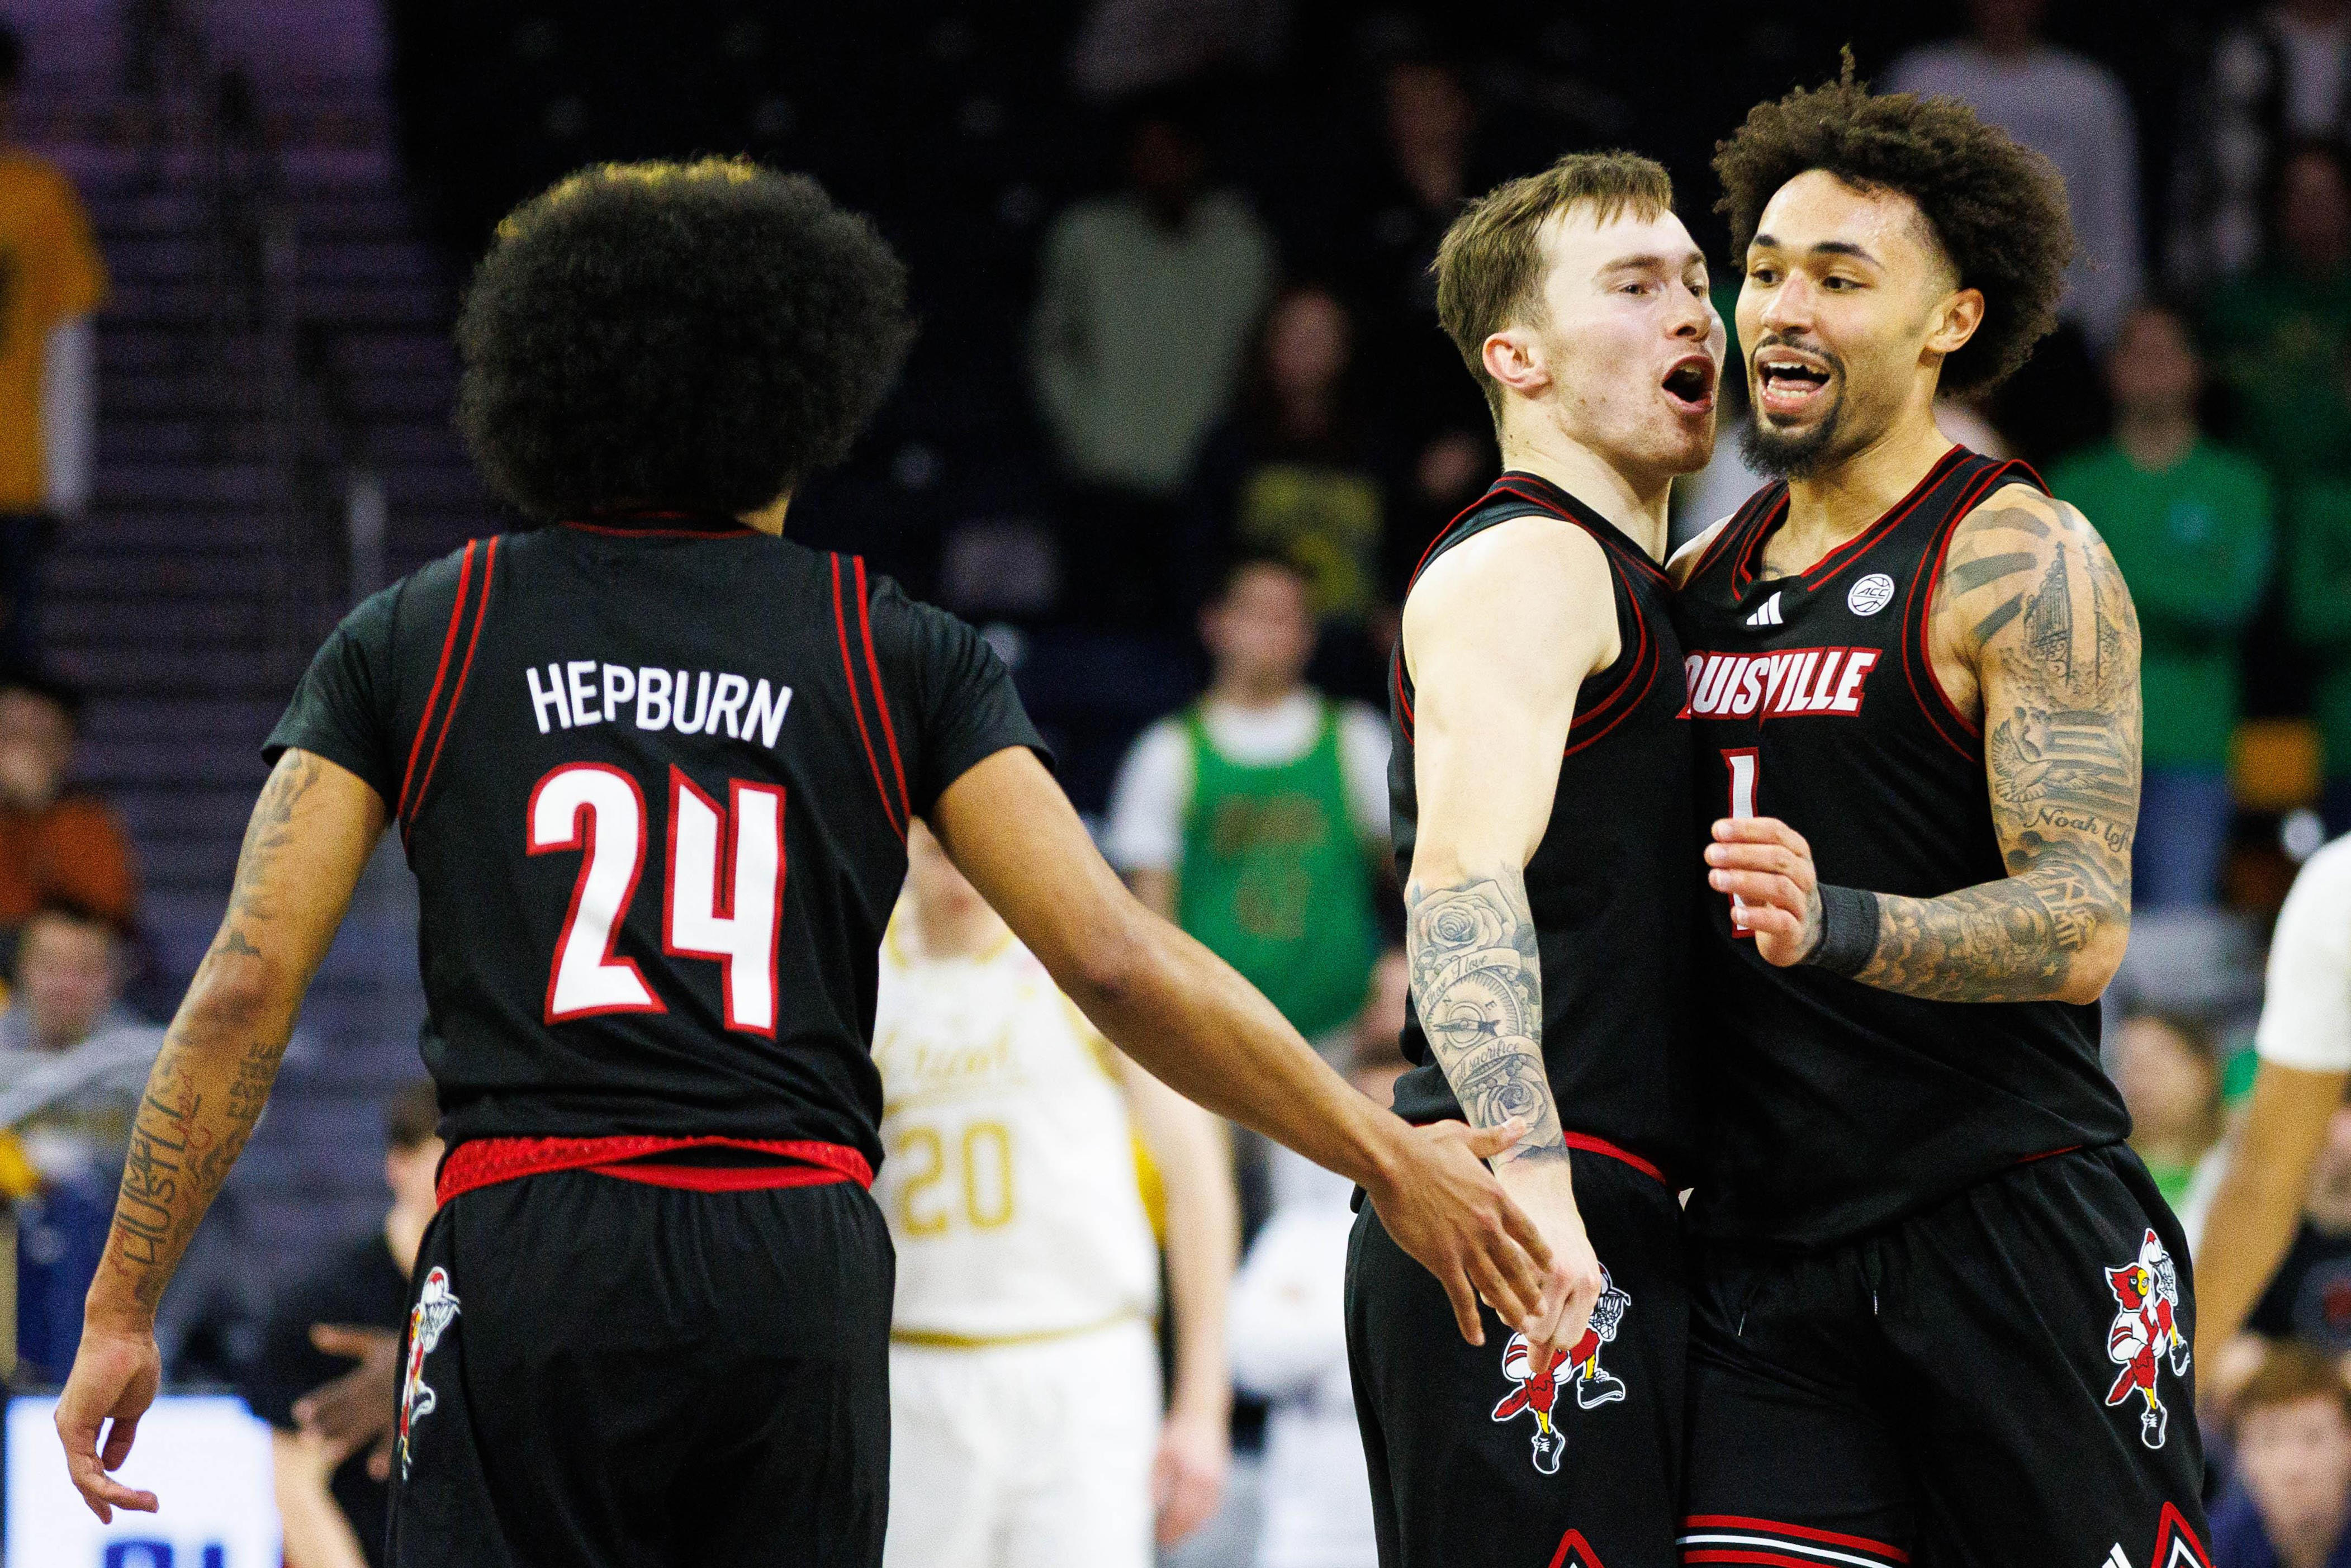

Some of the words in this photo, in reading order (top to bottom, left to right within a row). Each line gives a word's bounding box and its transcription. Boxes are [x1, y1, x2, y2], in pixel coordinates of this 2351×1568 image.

[1856, 587, 1890, 597] ACC
[526, 660, 793, 749] HEPBURN
[1676, 647, 1883, 721] OUISVILLE
[2023, 808, 2099, 835] Noah
[526, 761, 786, 1040] 24
[1464, 955, 1488, 974] love
[1470, 1038, 1519, 1068] sacrifice
[897, 1124, 1013, 1237] 20
